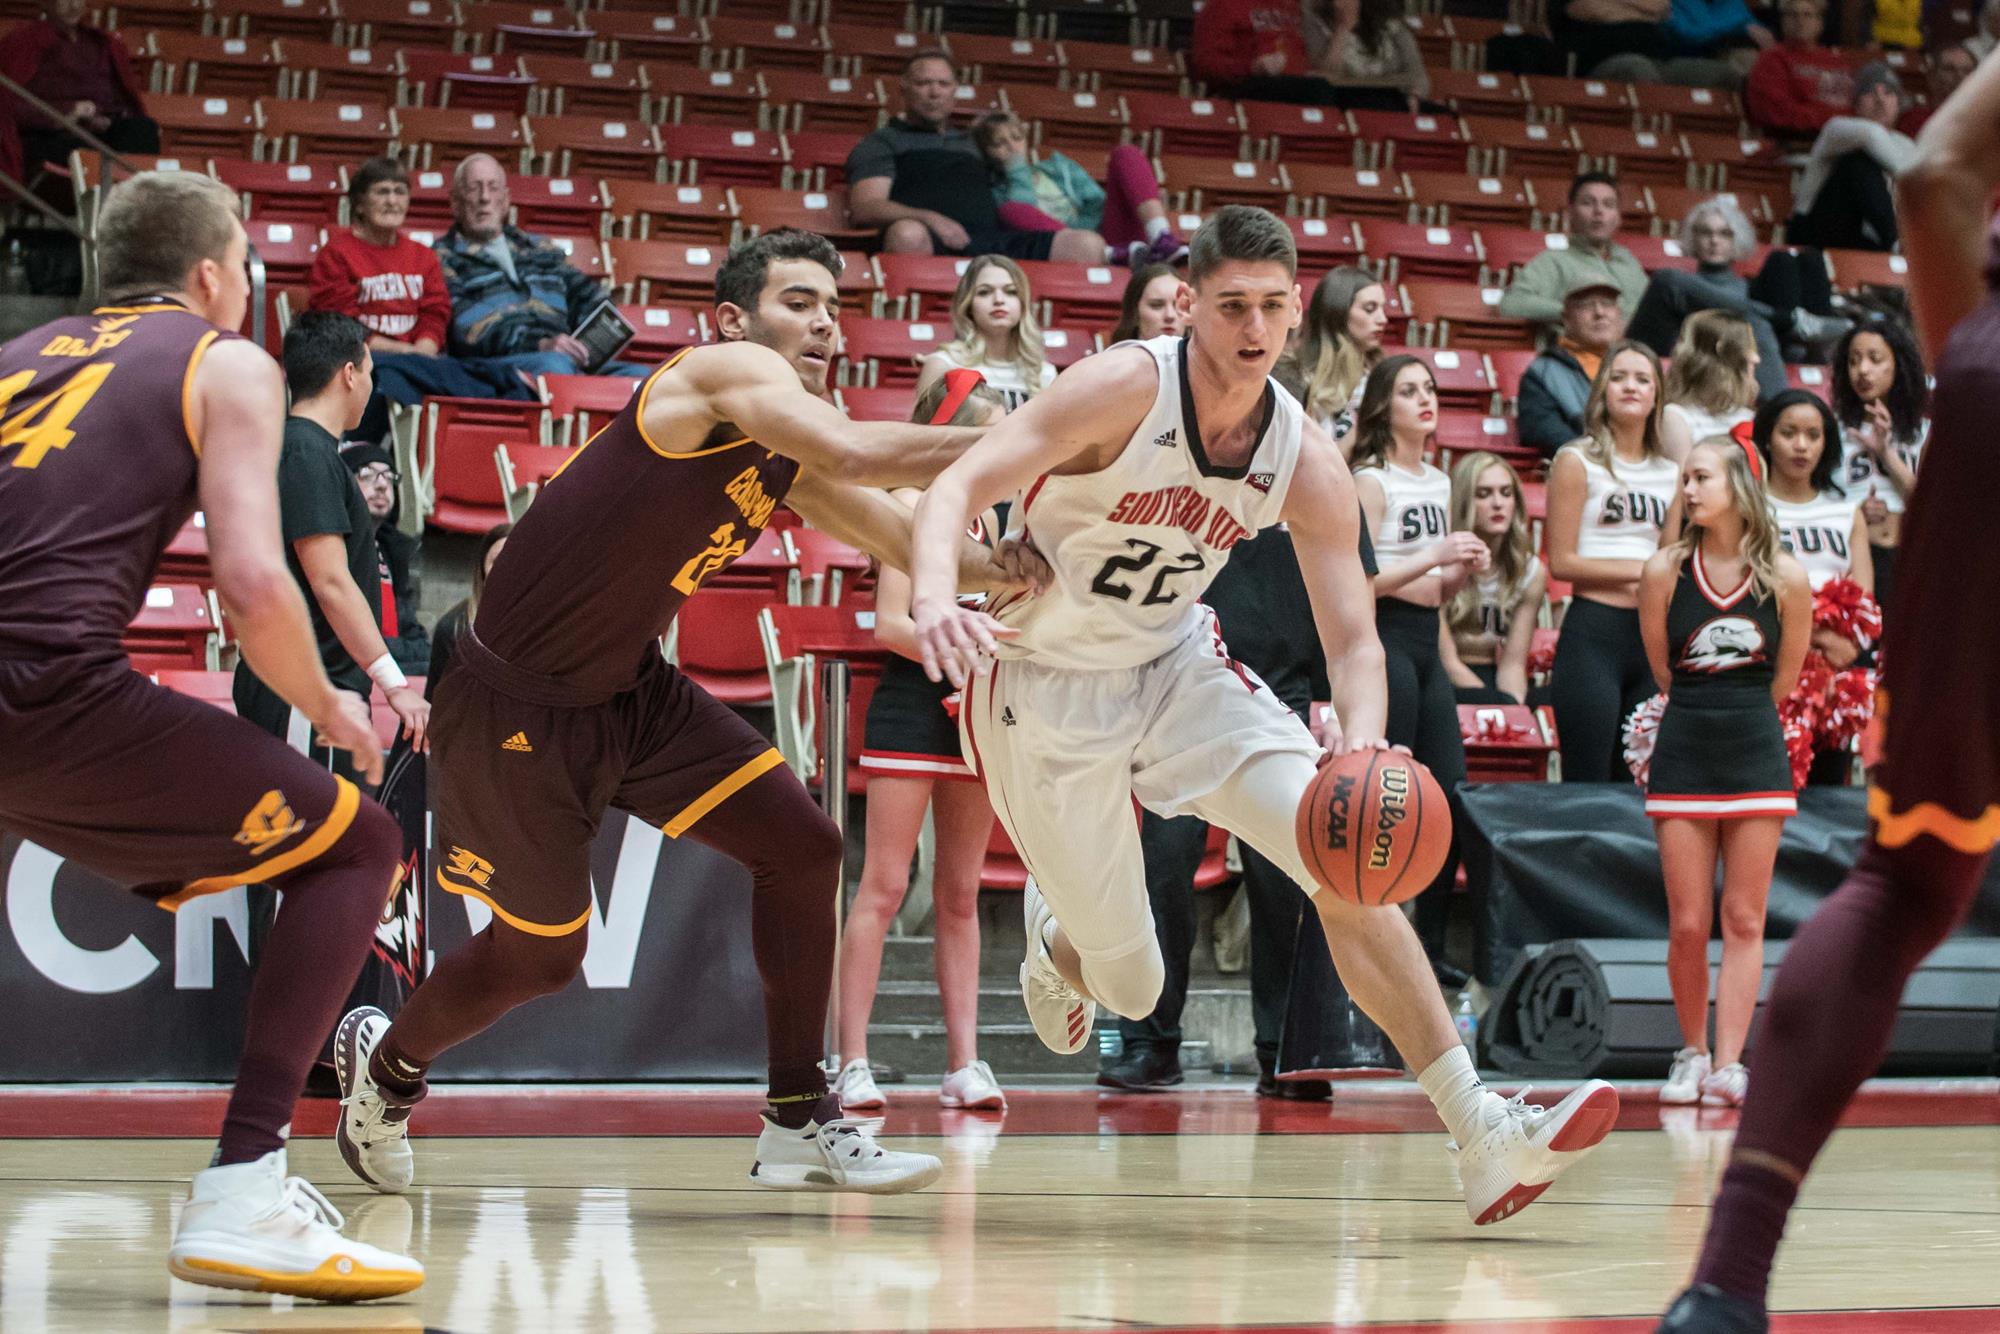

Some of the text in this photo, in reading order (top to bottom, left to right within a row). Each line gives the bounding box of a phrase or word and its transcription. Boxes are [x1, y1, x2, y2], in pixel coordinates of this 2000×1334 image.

[1254, 473, 1273, 487] SKY
[1601, 492, 1666, 529] SUU
[1090, 538, 1205, 605] 22
[501, 742, 533, 752] adidas
[1327, 775, 1356, 850] NCAA
[1368, 767, 1408, 870] Wilson
